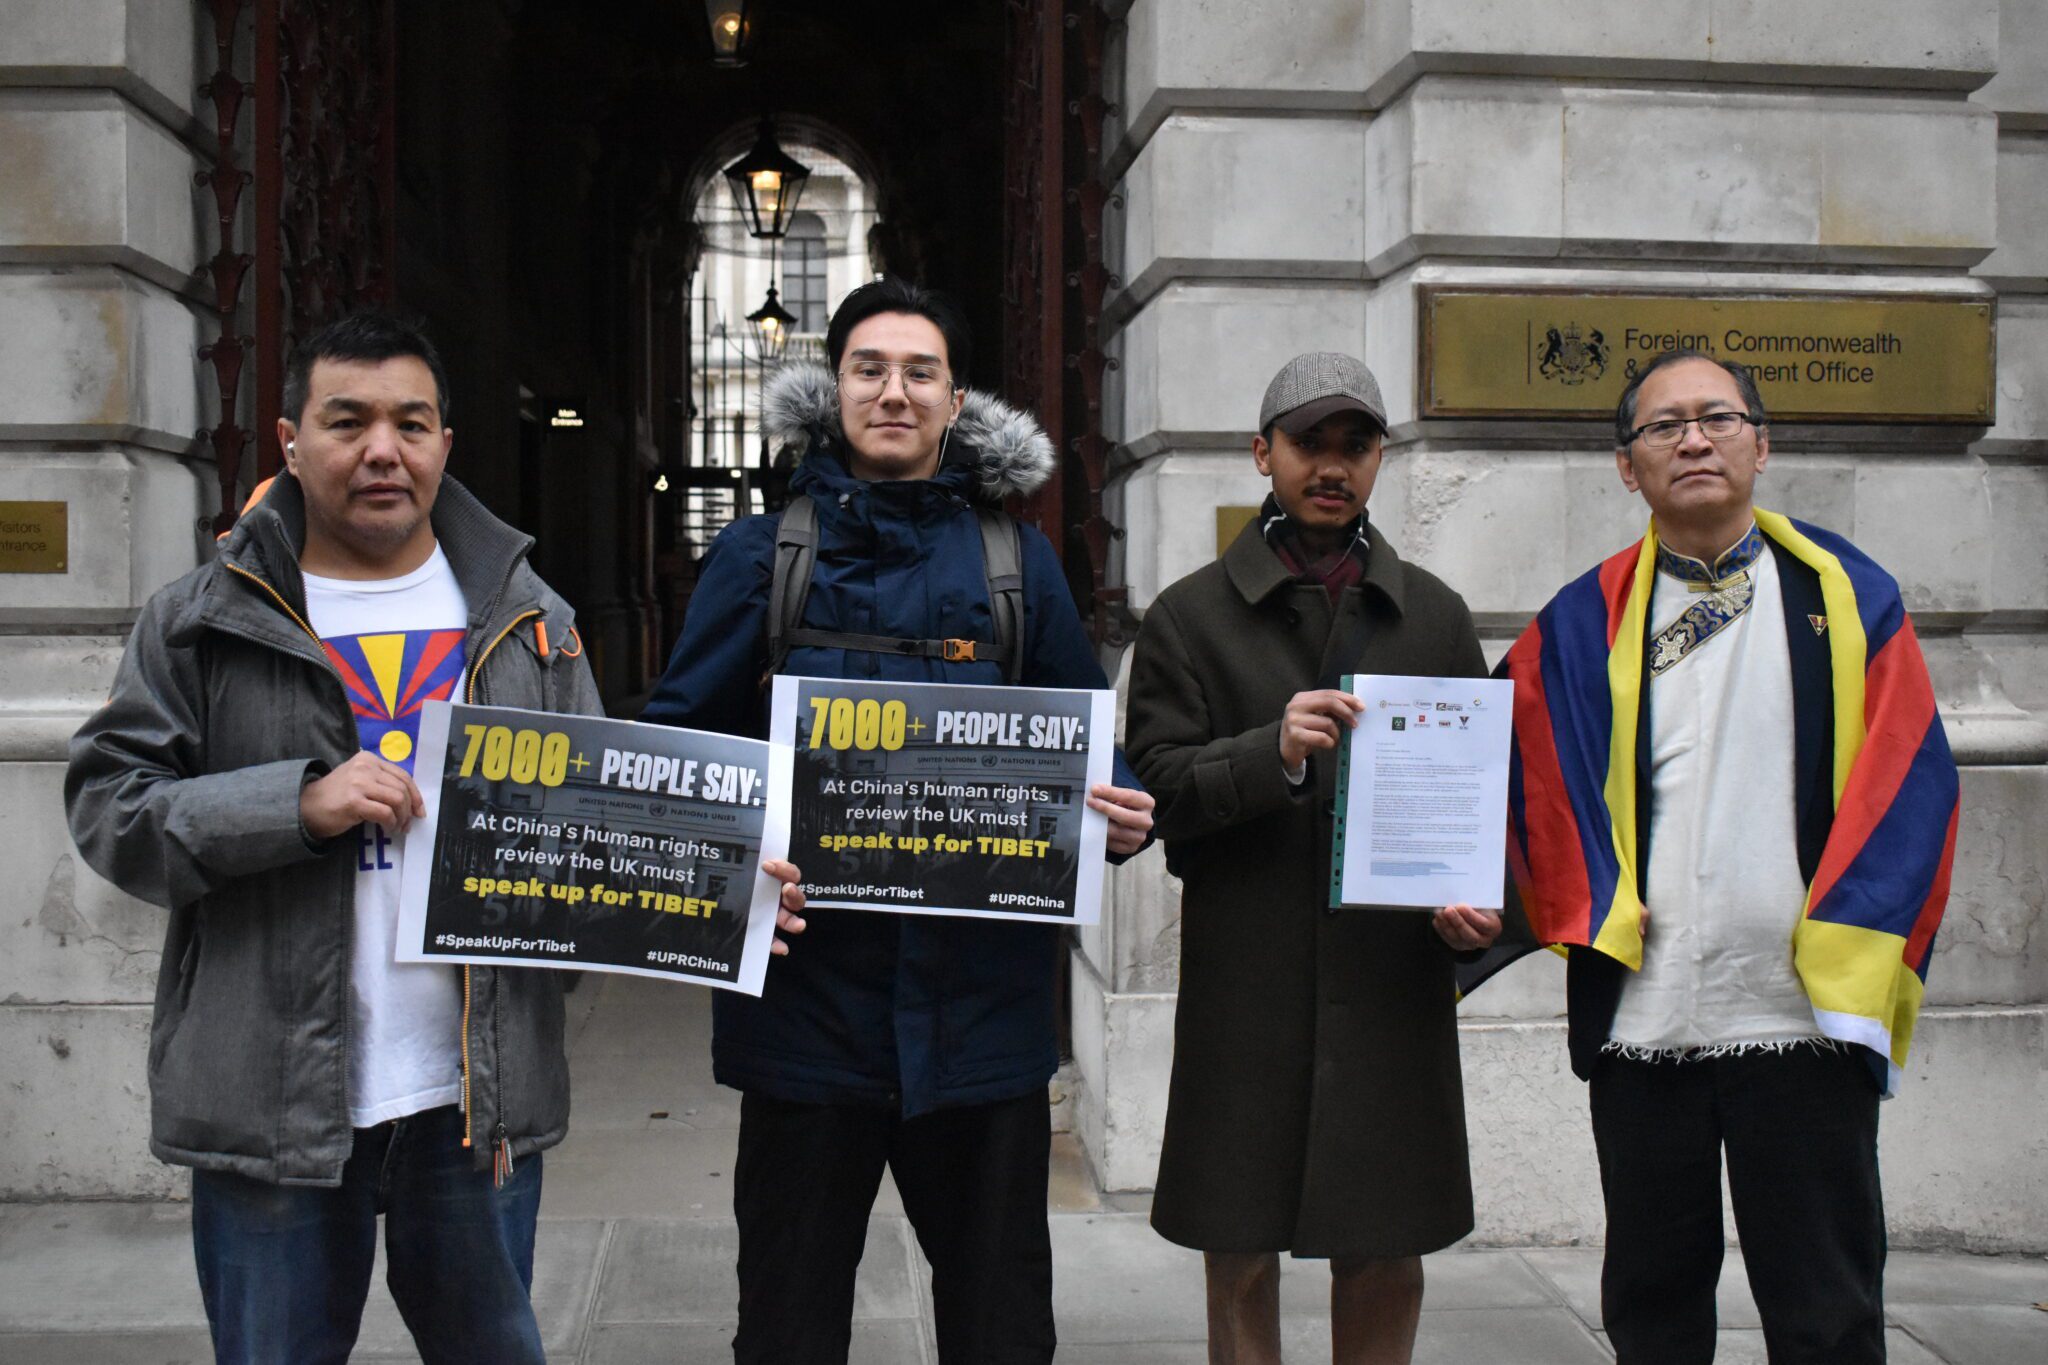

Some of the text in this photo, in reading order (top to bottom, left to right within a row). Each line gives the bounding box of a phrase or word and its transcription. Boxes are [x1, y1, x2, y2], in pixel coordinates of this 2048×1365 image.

[1625, 328, 1901, 355] Foreign, Commonwealth
[1624, 358, 1639, 380] &
[1806, 361, 1874, 383] Office
[0, 541, 47, 552] ntrance
[809, 697, 1084, 751] 7000+ PEOPLE SAY:
[460, 722, 763, 806] 7000+ PEOPLE SAY:
[824, 780, 1048, 803] At China's human rights
[847, 805, 975, 823] review the UK
[472, 814, 719, 859] At China's human rights
[819, 832, 1051, 859] must speak up for
[496, 847, 695, 883] review the UK must
[464, 878, 717, 918] speak up for TIBET
[800, 884, 924, 899] #SpeakUpForTibet
[435, 934, 576, 954] #SpeakUpForTibet
[646, 950, 730, 973] #UPRChina
